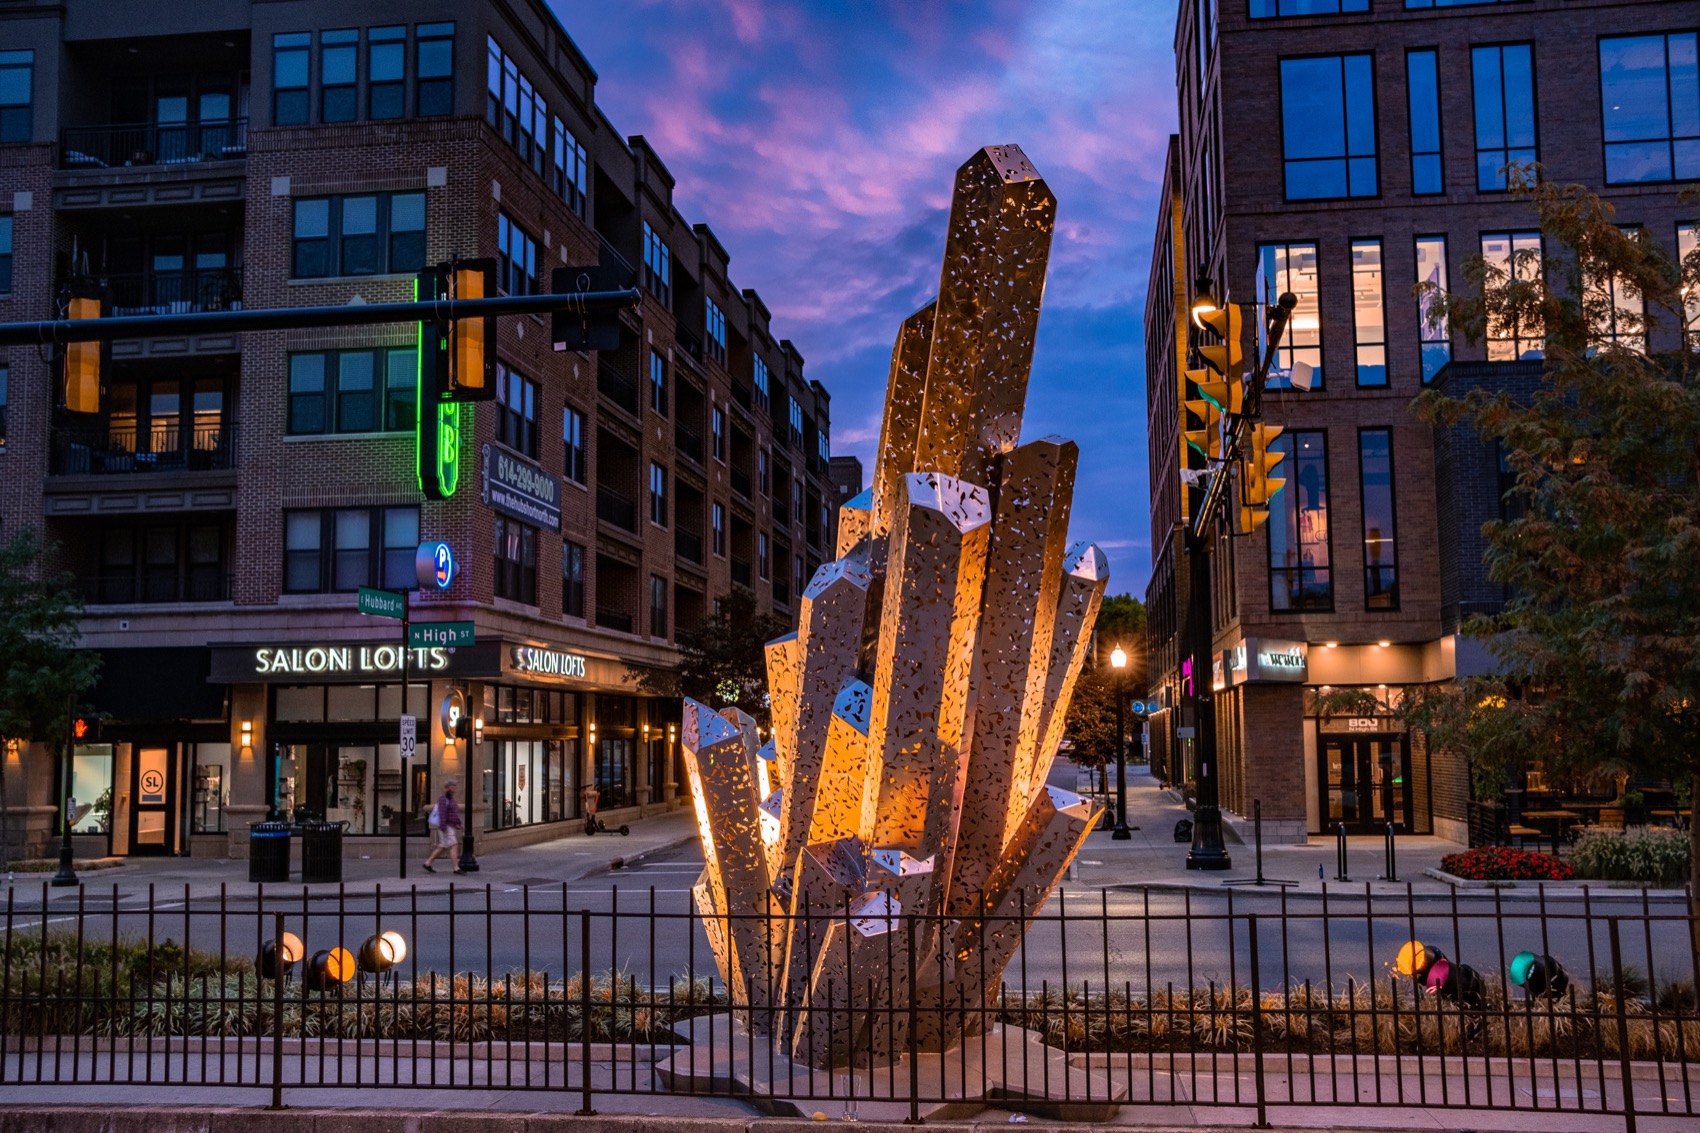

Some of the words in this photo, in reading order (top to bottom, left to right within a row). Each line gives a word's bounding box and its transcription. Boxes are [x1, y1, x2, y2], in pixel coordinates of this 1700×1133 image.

[498, 455, 554, 503] 614-299-9000
[439, 548, 447, 568] P
[365, 593, 395, 611] Hubbard
[414, 632, 420, 640] N
[423, 628, 457, 645] High
[460, 630, 470, 638] ST
[255, 648, 349, 673] SALON
[527, 648, 559, 674] SALON
[560, 653, 586, 677] LOFTS
[1348, 718, 1378, 727] 800
[402, 736, 415, 752] 30
[145, 776, 159, 788] SL
